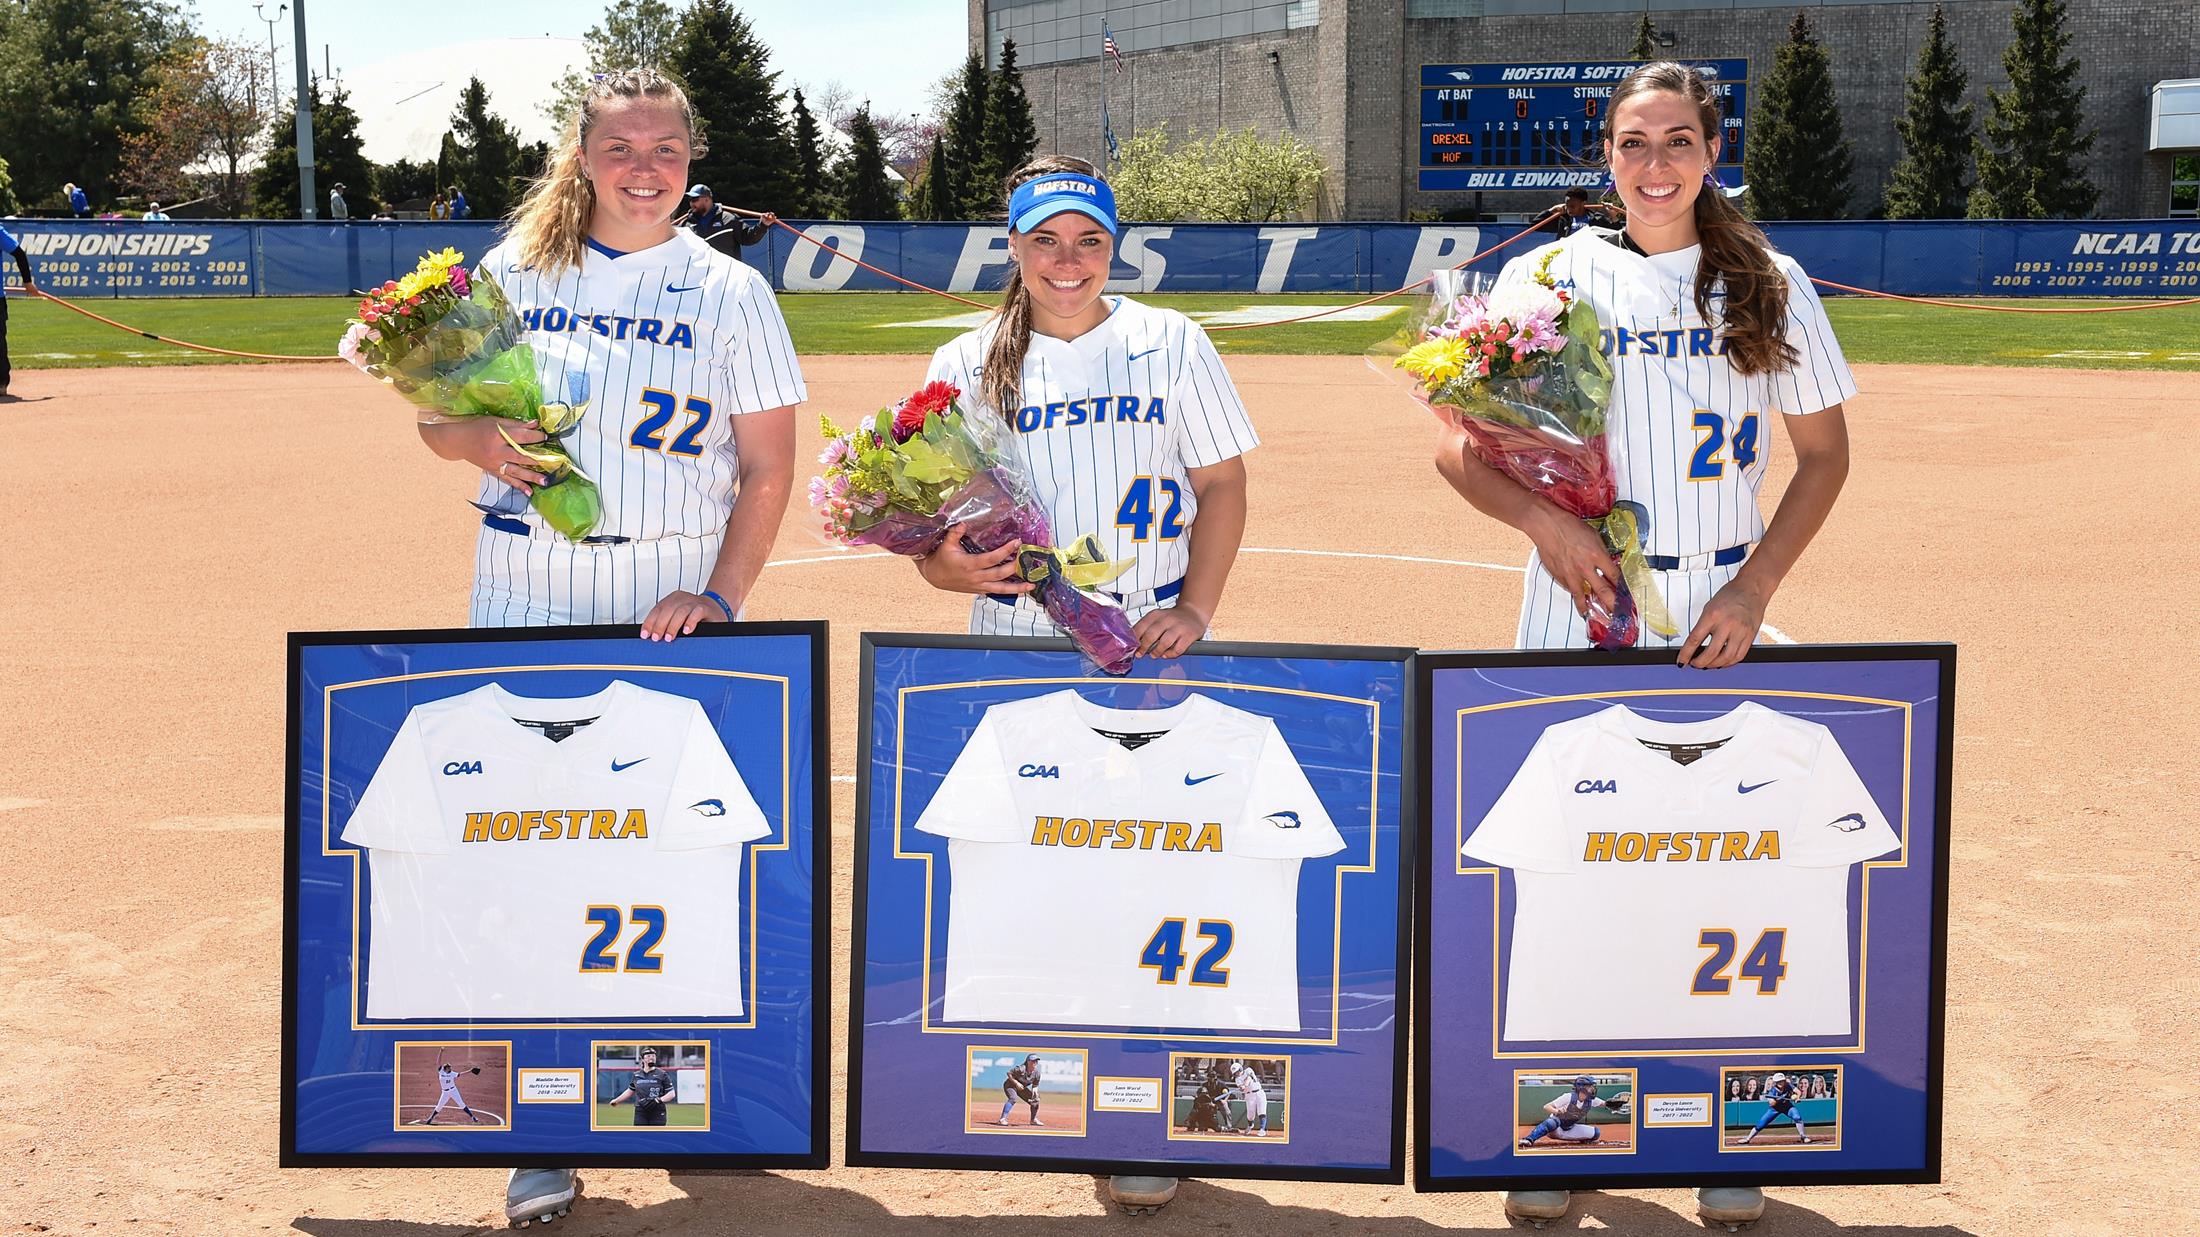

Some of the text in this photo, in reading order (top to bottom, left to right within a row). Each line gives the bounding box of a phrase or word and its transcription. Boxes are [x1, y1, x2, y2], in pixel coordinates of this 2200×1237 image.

[1502, 66, 1635, 82] HOFSTRA SOFTB
[1437, 89, 1473, 101] AT BAT
[1508, 88, 1536, 100] BALL
[1573, 87, 1612, 99] STRIKE
[1516, 100, 1528, 119] 0
[1585, 99, 1597, 117] 0
[1485, 120, 1605, 131] 1 2 3 4 5 6 7 8
[1724, 118, 1743, 128] ERR
[1432, 133, 1472, 145] DREXEL
[1442, 152, 1461, 163] HOF
[1467, 173, 1506, 188] BILL
[1512, 172, 1602, 188] EDWARDS
[1033, 180, 1097, 197] HOFSTRA
[10, 233, 212, 255] MPIONSHIPS
[2072, 232, 2162, 255] NCAA
[39, 261, 81, 273] 2000
[97, 261, 134, 273] 2001
[151, 261, 191, 273] 2002
[207, 261, 246, 272] 2003
[2015, 262, 2051, 273] 1993
[2067, 262, 2104, 273] 1995
[2120, 261, 2158, 273] 1999
[52, 275, 89, 287] 2012
[105, 275, 143, 287] 2013
[159, 275, 196, 286] 2015
[212, 274, 248, 286] 2018
[1555, 277, 1577, 289] AA
[1992, 275, 2198, 287] 2006 2007 2008 2010
[523, 306, 693, 350] HOFSTRA
[1599, 326, 1727, 359] OFSTR
[628, 386, 714, 458] 22
[1015, 395, 1165, 434] OFSTRA
[1686, 409, 1759, 483] 24
[1114, 474, 1186, 543] 42
[443, 760, 483, 776] CAA
[1018, 763, 1060, 779] CAA
[1574, 779, 1617, 794] CAA
[462, 809, 649, 843] HOFSTRA
[1030, 815, 1224, 852] HOFSTRA
[1583, 830, 1781, 862] HOFSTRA
[579, 904, 668, 974] 22
[1138, 916, 1236, 988] 42
[1690, 927, 1788, 996] 24
